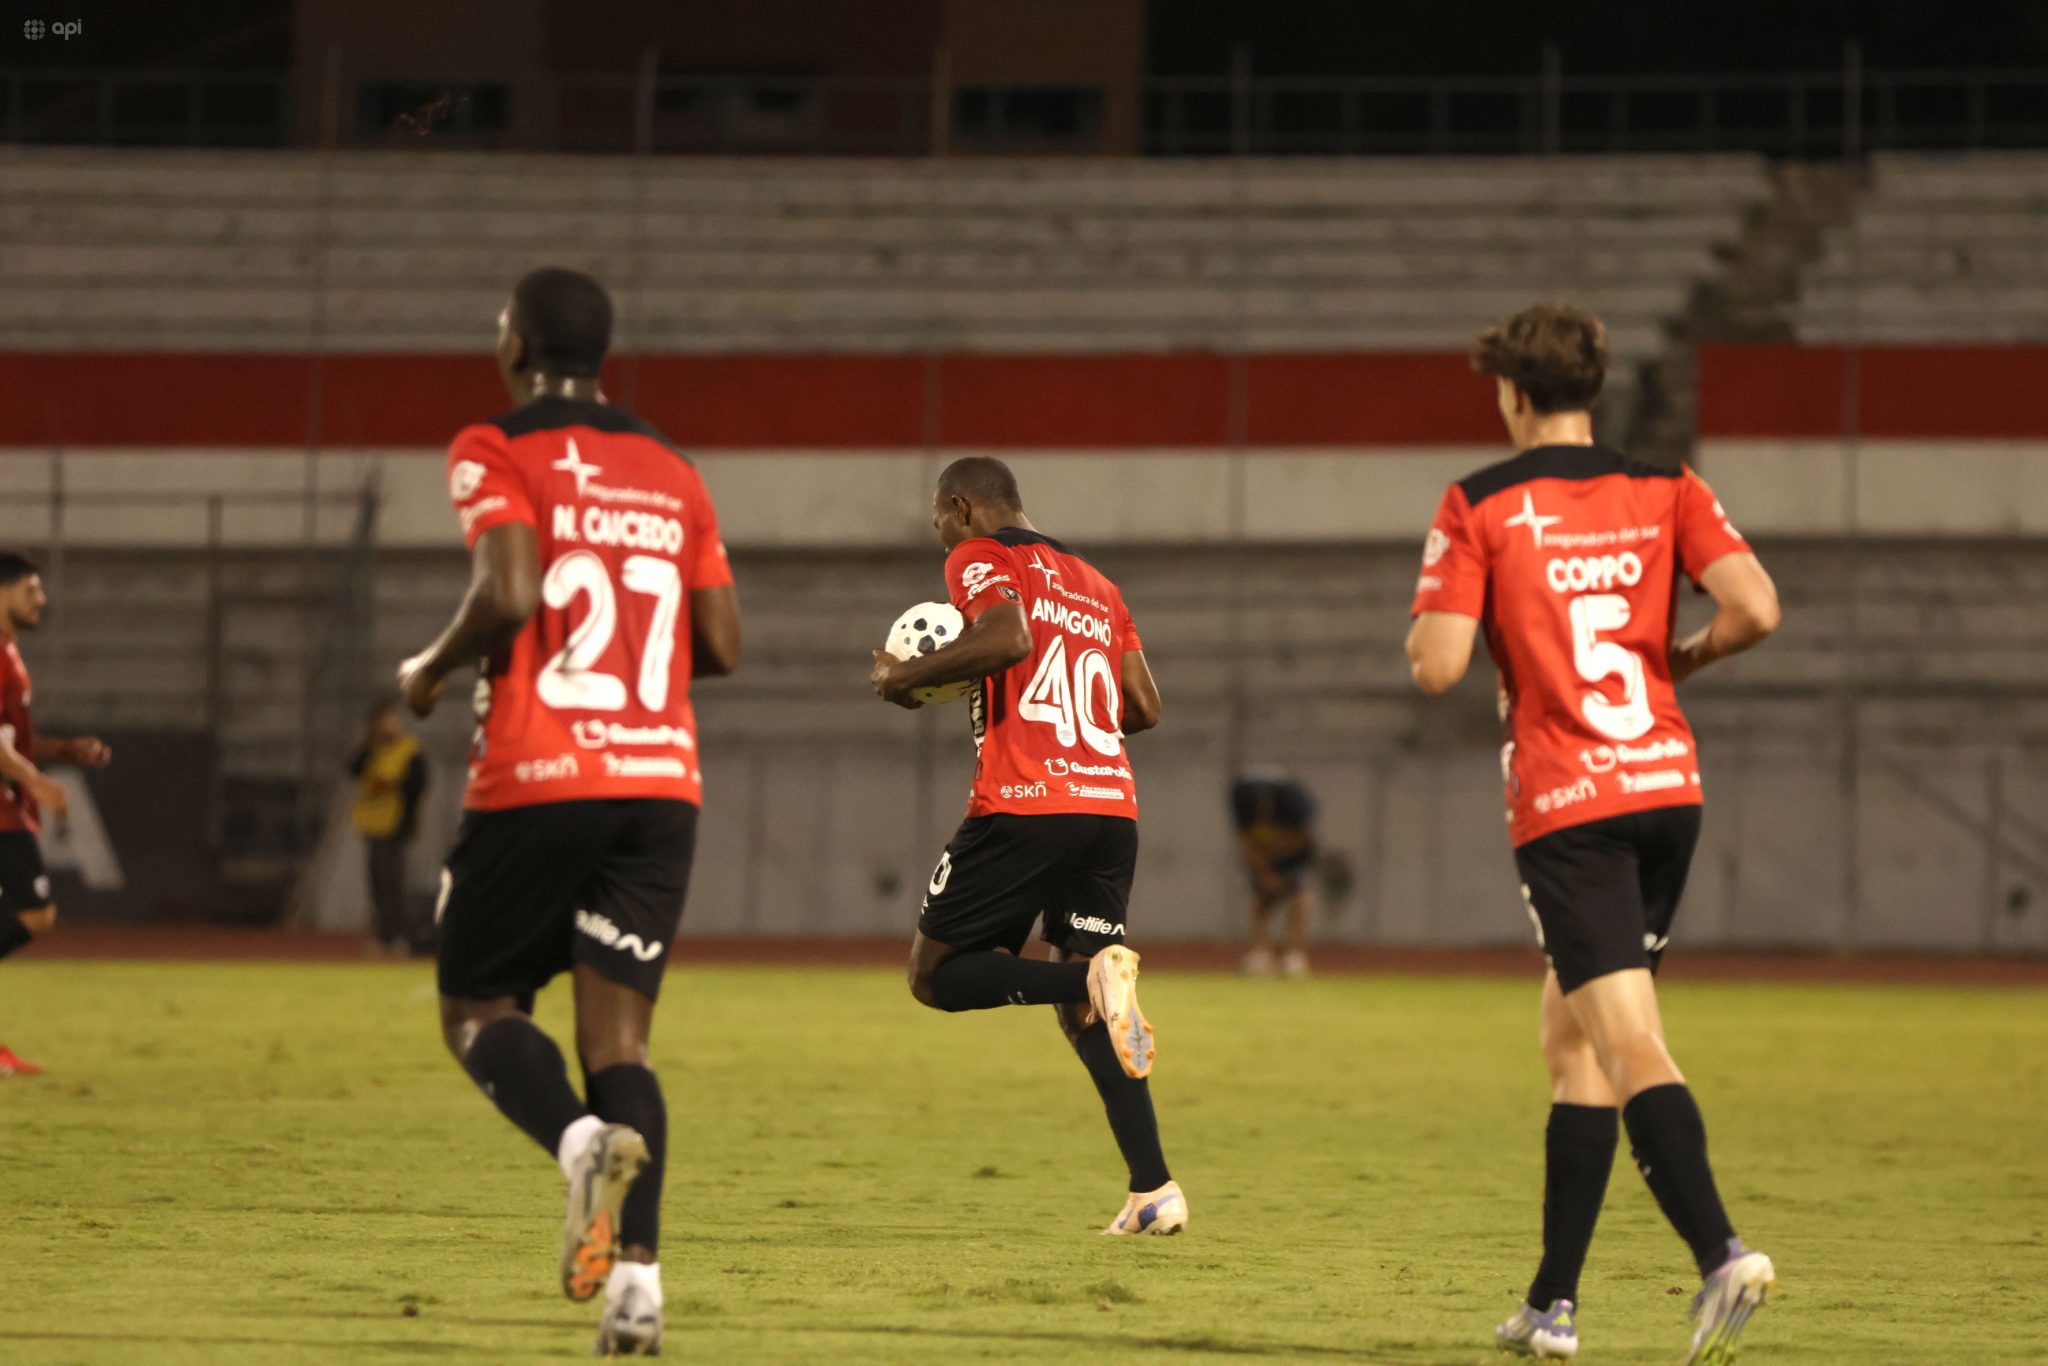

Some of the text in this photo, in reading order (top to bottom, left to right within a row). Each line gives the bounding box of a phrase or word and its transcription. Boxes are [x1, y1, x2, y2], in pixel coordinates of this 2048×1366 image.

[553, 504, 581, 541] N.
[583, 506, 684, 556] CAICEDO
[1546, 551, 1643, 592] COPPO
[537, 549, 682, 713] 27
[1569, 594, 1655, 741] 5
[1018, 634, 1122, 757] 40
